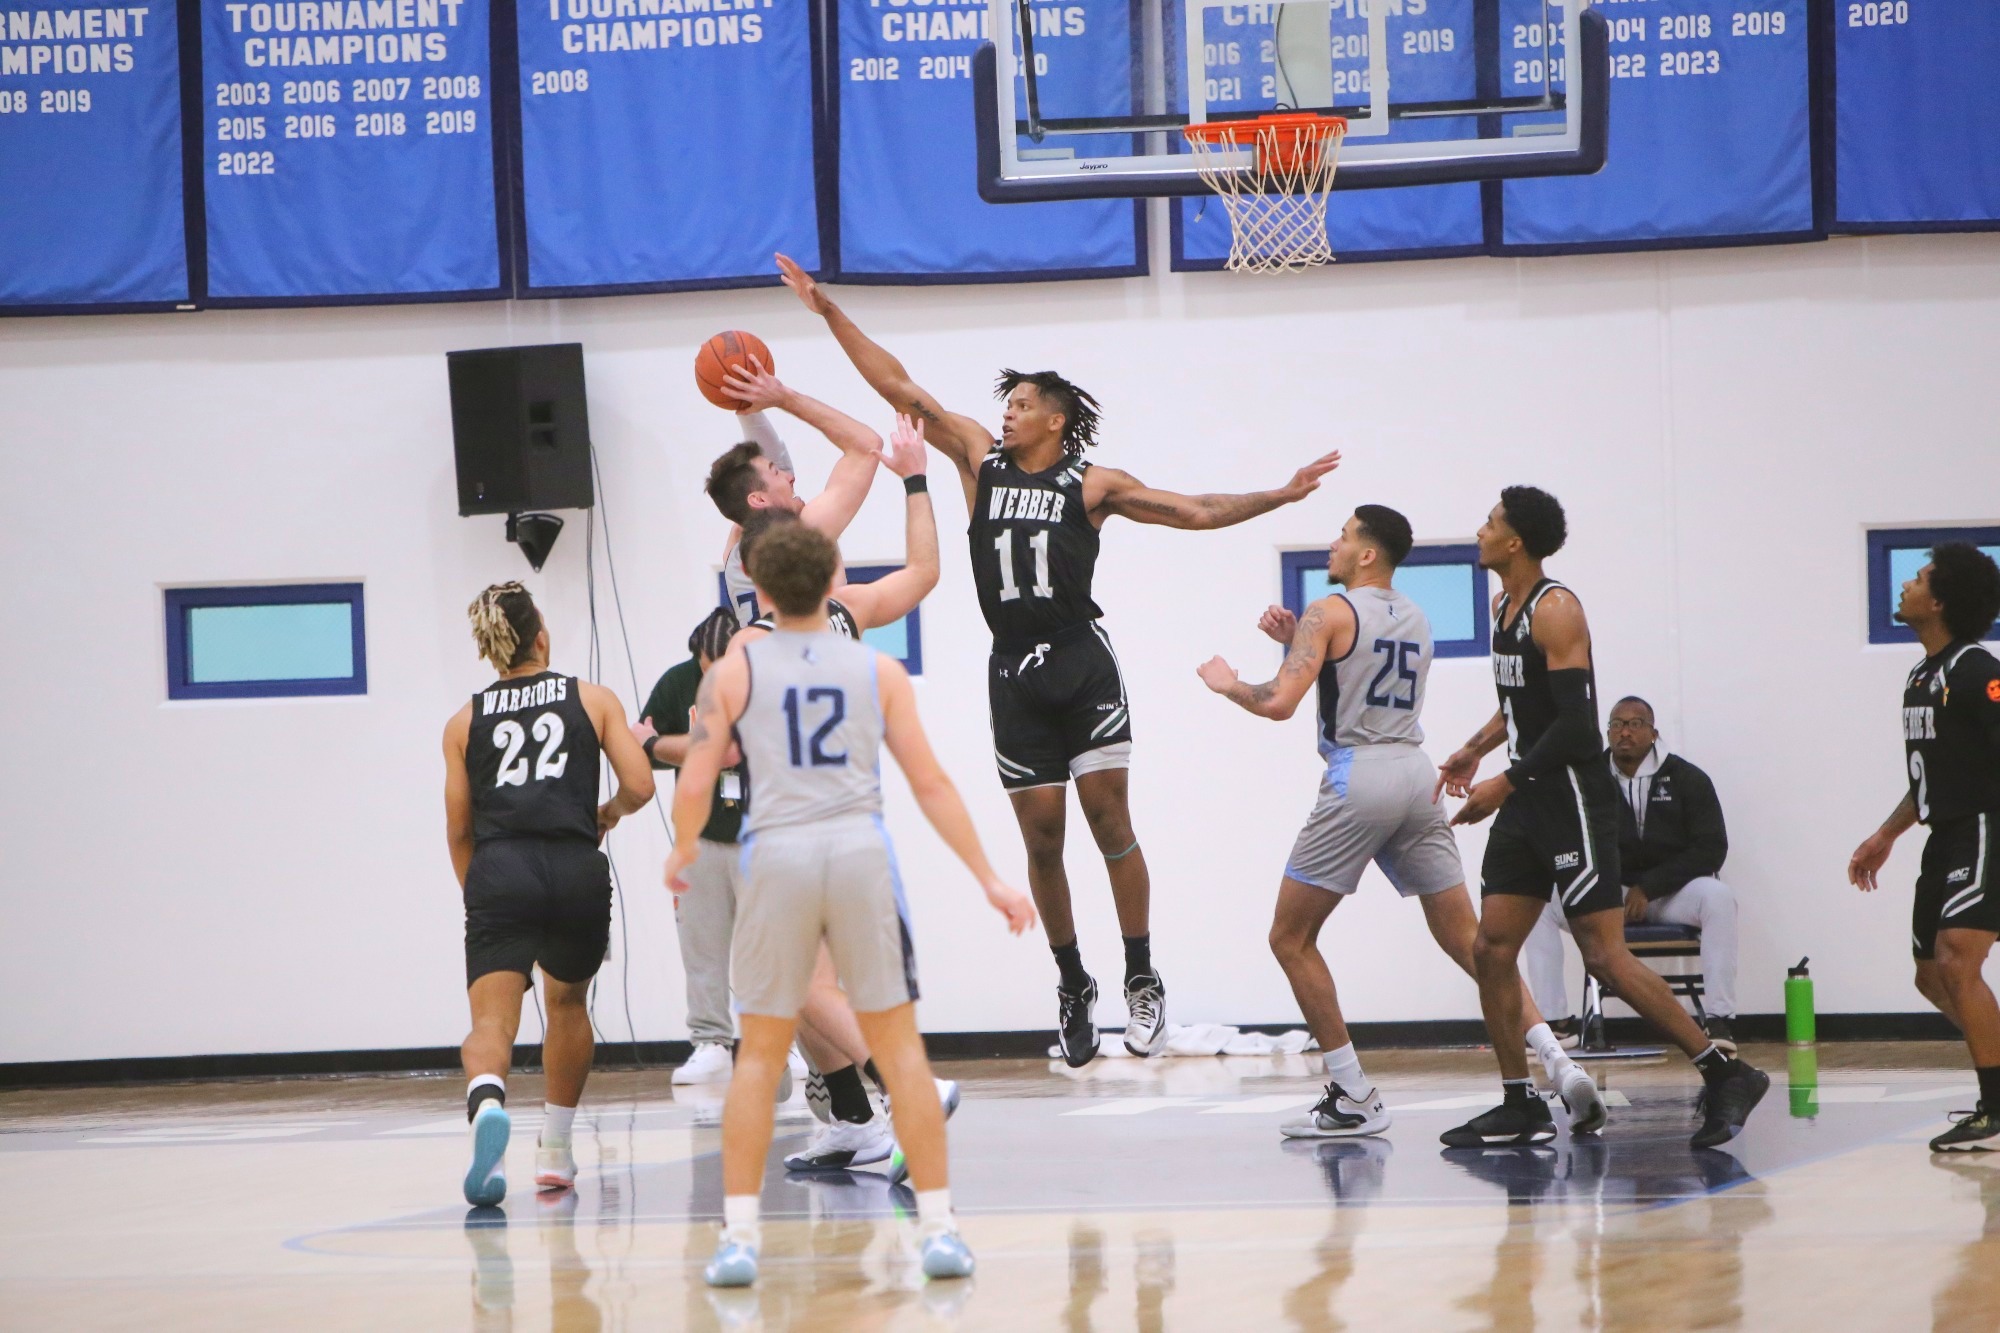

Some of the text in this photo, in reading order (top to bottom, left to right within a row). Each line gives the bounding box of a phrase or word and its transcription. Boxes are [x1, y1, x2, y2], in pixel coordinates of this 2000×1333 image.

[225, 0, 463, 33] TOURNAMENT
[549, 0, 774, 20] TOURN
[882, 7, 1085, 42] CHAMONS
[1659, 14, 1711, 40] 2018
[1732, 11, 1786, 37] 2019
[1848, 2, 1909, 27] 2020
[244, 33, 447, 67] CHAMPIONS
[562, 14, 762, 54] CHAMPIONS
[1204, 42, 1240, 67] 016
[1332, 34, 1368, 59] 201
[1403, 28, 1454, 55] 2019
[0, 43, 134, 75] MPIONS
[850, 56, 971, 81] 2012 2014
[1660, 50, 1720, 76] 2023
[216, 75, 481, 107] 2003 2006 2007 2008
[532, 68, 589, 95] 2008
[1205, 77, 1241, 102] 021
[41, 89, 91, 113] 2019
[217, 110, 476, 141] 2015 2016 2018 2019
[217, 151, 275, 175] 2022
[988, 486, 1066, 524] WEBBER
[994, 528, 1054, 602] 11
[1366, 638, 1420, 711] 25
[482, 677, 568, 716] WARRIORS
[783, 686, 847, 768] 12
[492, 711, 568, 788] 22
